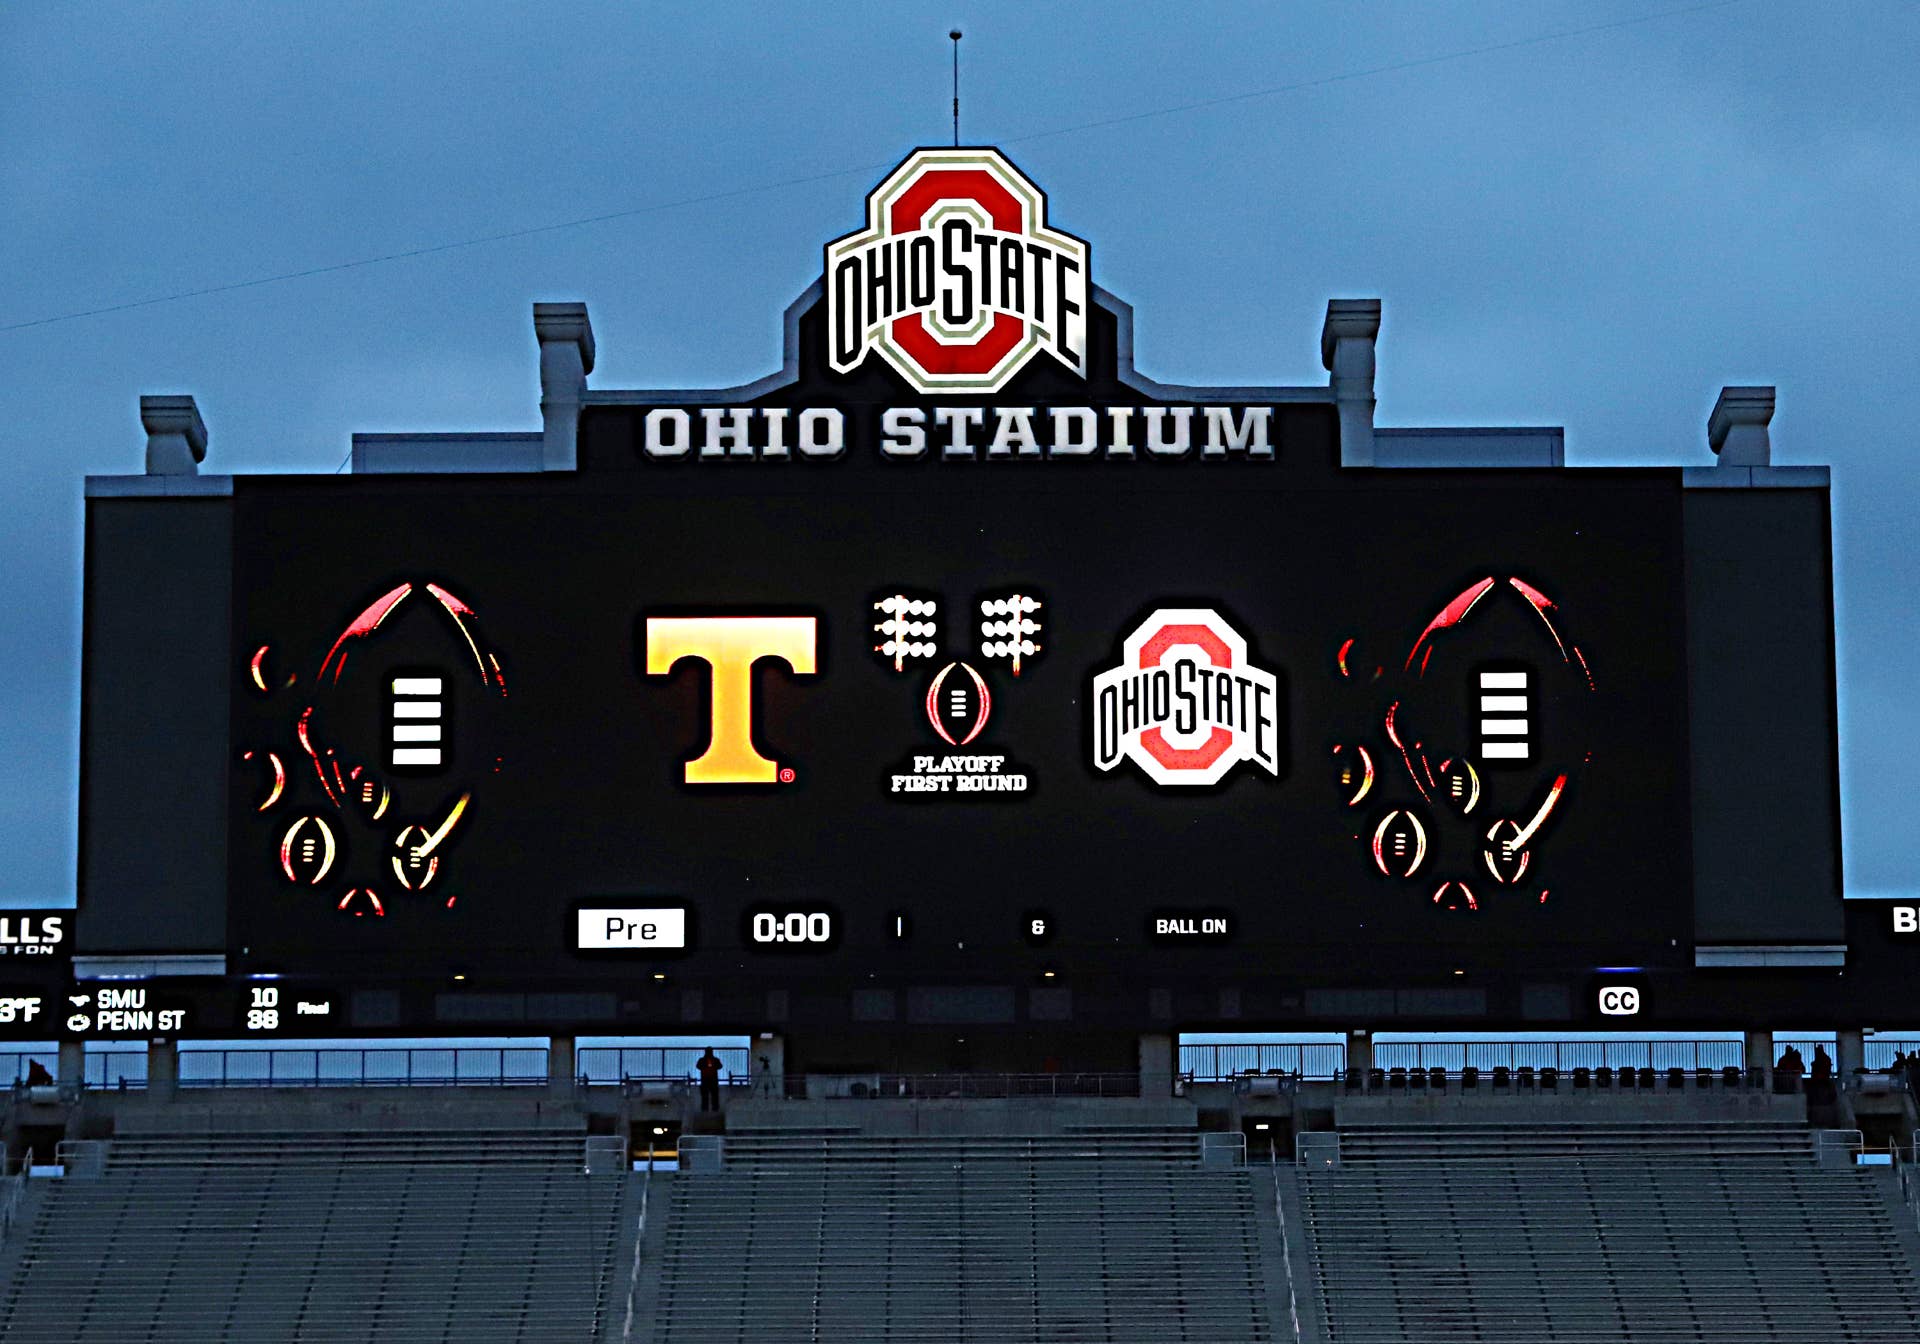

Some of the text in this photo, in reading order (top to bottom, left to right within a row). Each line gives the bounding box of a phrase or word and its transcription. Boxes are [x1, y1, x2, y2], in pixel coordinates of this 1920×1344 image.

[835, 218, 1081, 365] OHIO STATE
[644, 406, 1275, 457] OHIO STADIUM
[646, 616, 817, 783] T
[1100, 658, 1273, 764] OHIO STATE
[913, 755, 1005, 773] PLAYOFF
[891, 774, 1028, 792] FIRST ROUND
[605, 917, 658, 941] Pre
[753, 912, 831, 943] 0:00
[1031, 919, 1046, 935] &
[1156, 918, 1227, 934] BALL ON
[1893, 906, 1920, 933] B
[97, 988, 146, 1009] SMU
[251, 987, 279, 1008] 10
[1603, 991, 1636, 1011] CC
[97, 1010, 186, 1031] PENN ST
